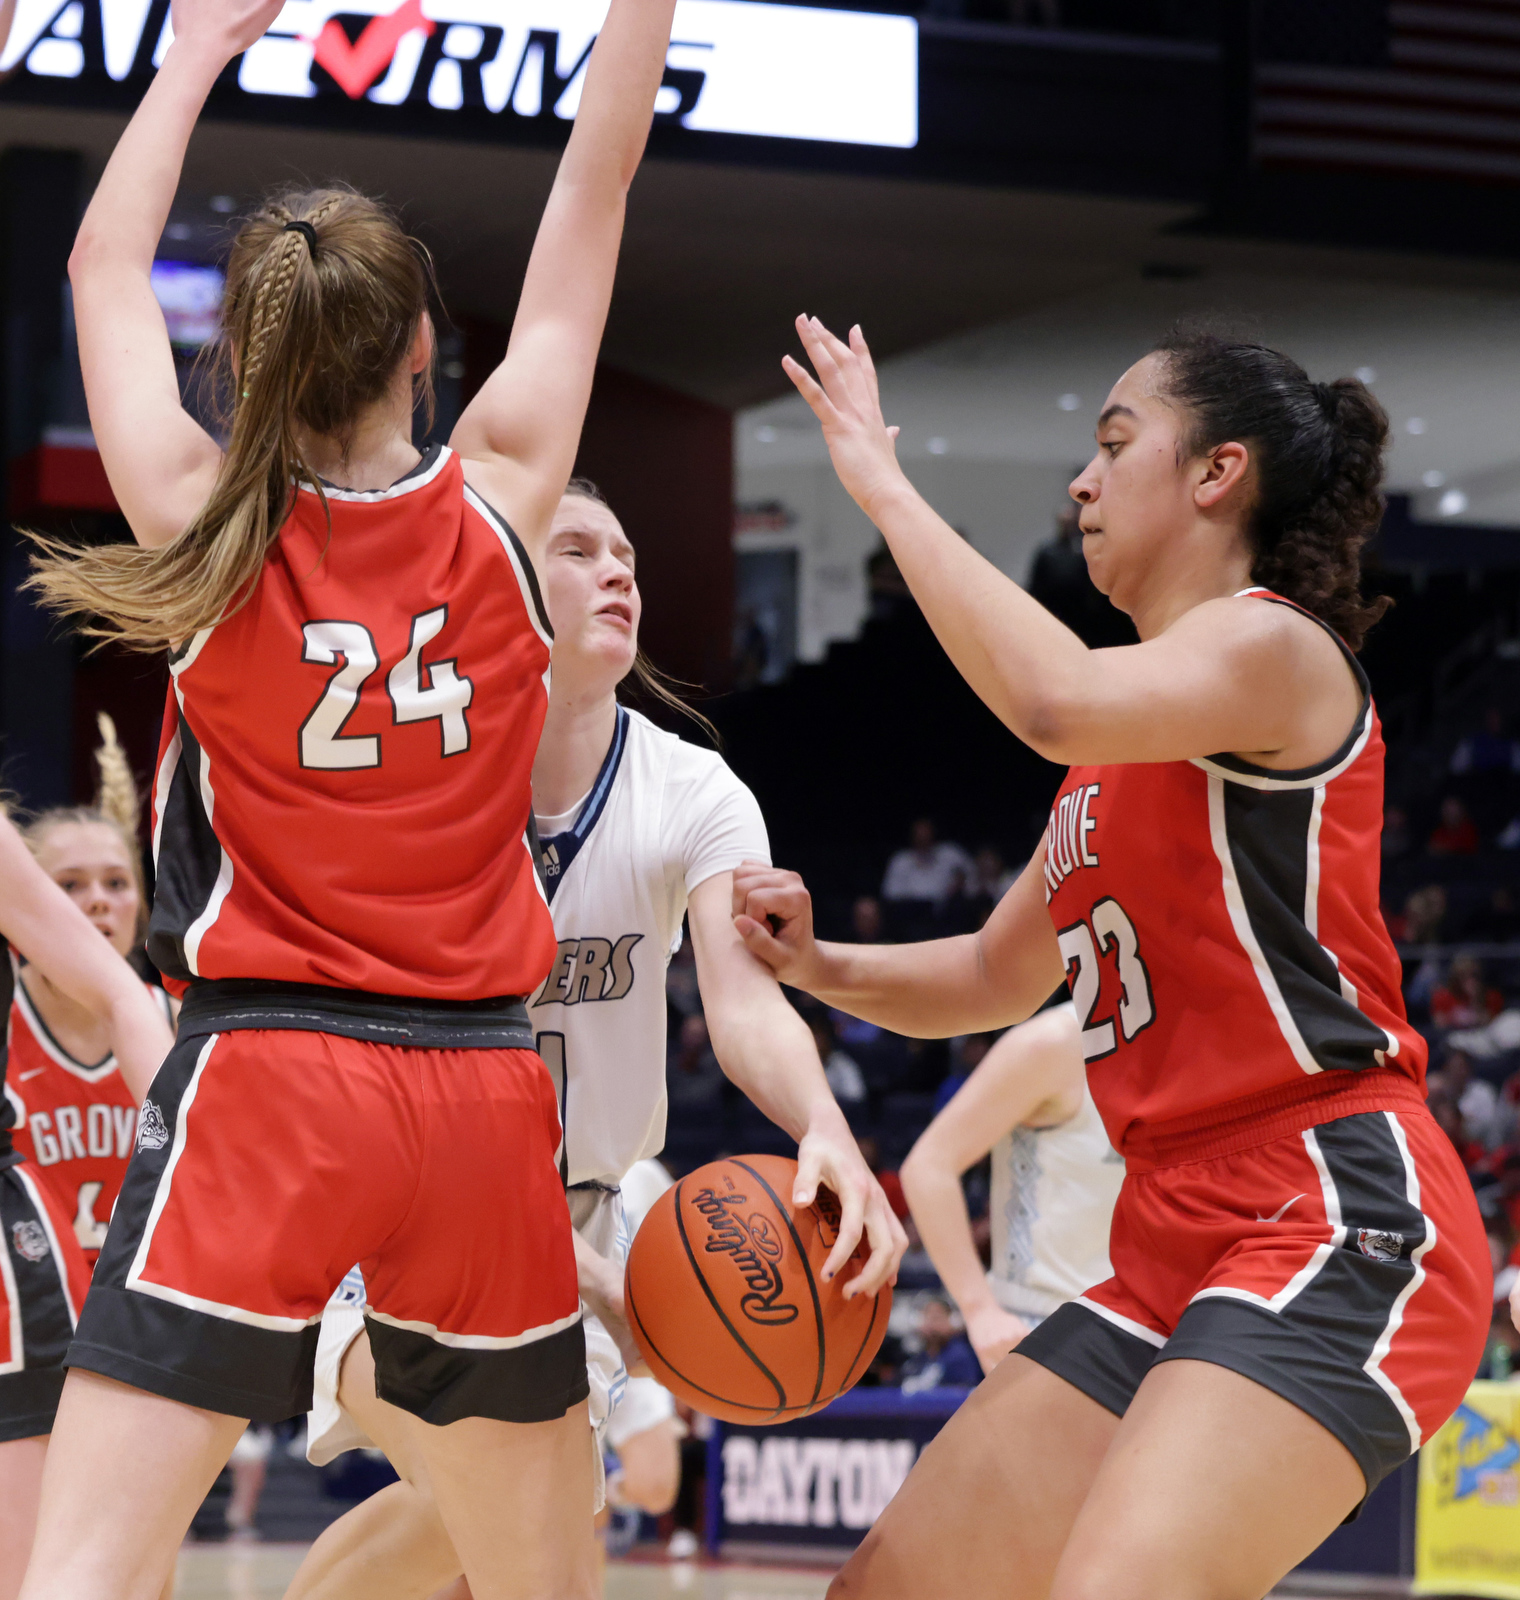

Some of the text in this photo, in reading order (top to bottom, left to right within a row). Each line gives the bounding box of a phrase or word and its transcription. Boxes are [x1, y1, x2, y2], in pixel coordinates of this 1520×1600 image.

[298, 602, 475, 772] 24
[524, 933, 645, 1008] ERS
[1057, 895, 1157, 1065] 23
[29, 1103, 138, 1167] GROV
[691, 1189, 799, 1326] Rawlings
[721, 1435, 917, 1529] DAYTON
